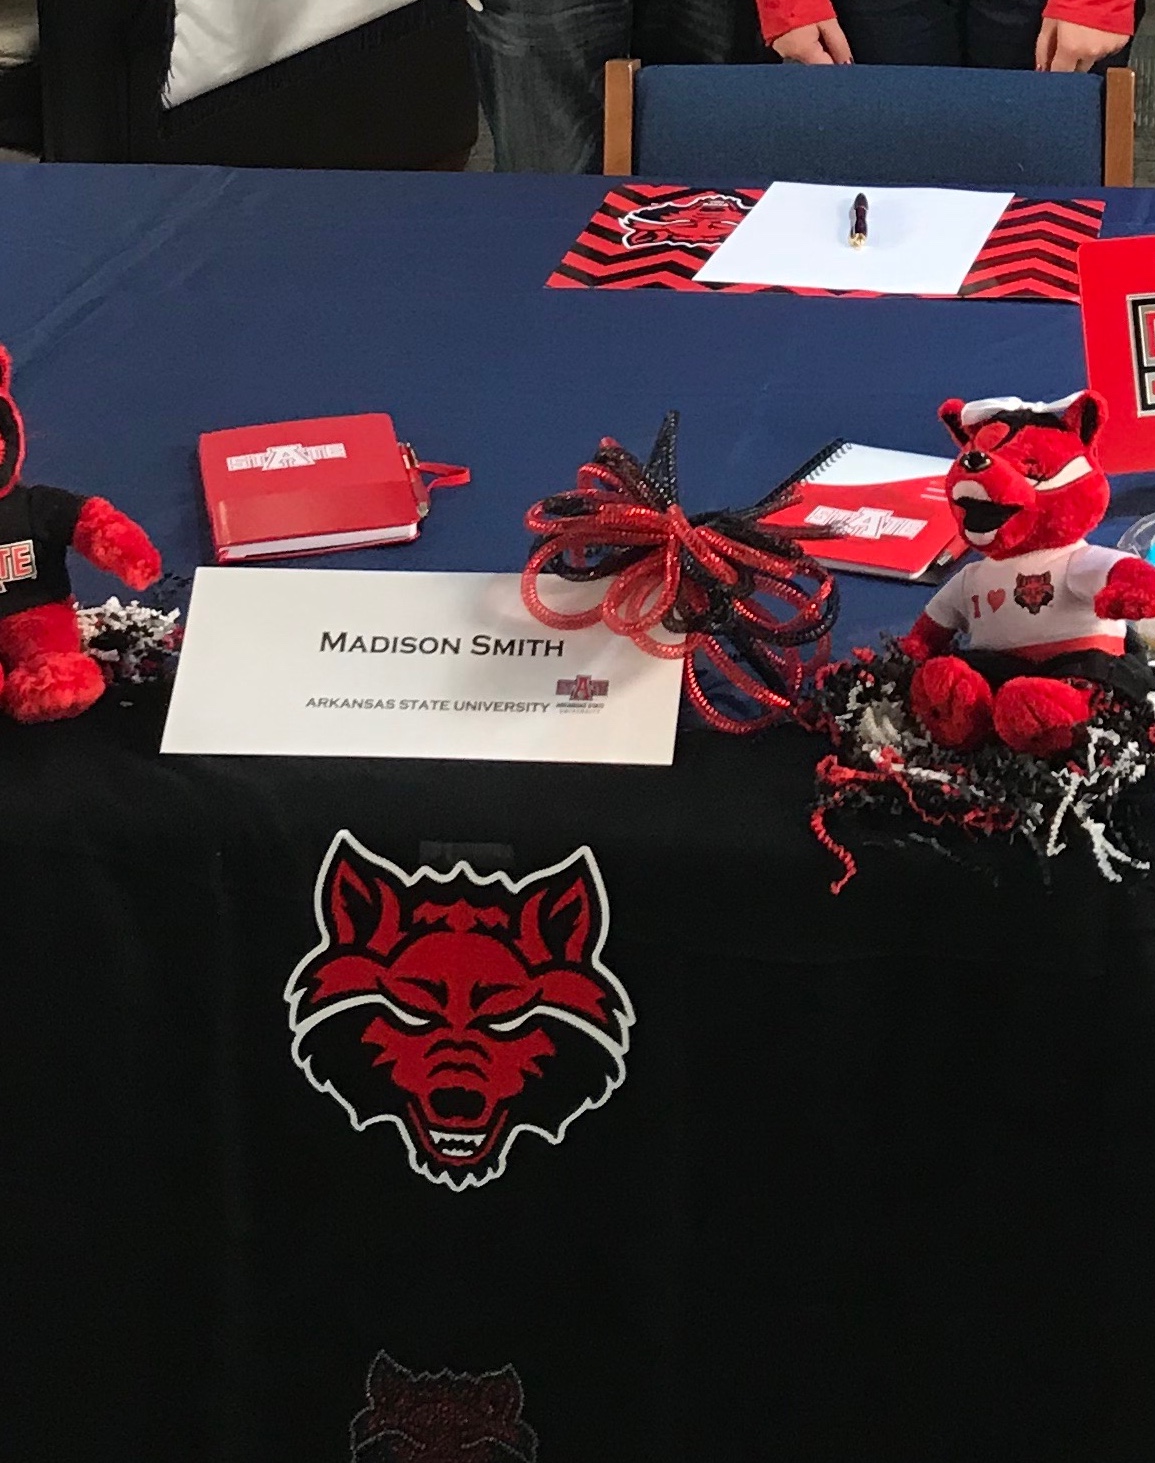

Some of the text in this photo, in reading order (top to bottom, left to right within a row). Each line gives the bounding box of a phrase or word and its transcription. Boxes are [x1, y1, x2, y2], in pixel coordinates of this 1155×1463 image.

[0, 542, 34, 592] TE
[971, 594, 981, 618] I
[319, 630, 565, 657] MADISON SMITH
[305, 696, 396, 710] ARKANSAS
[399, 698, 451, 711] STATE
[453, 699, 550, 713] UNIVERSITY
